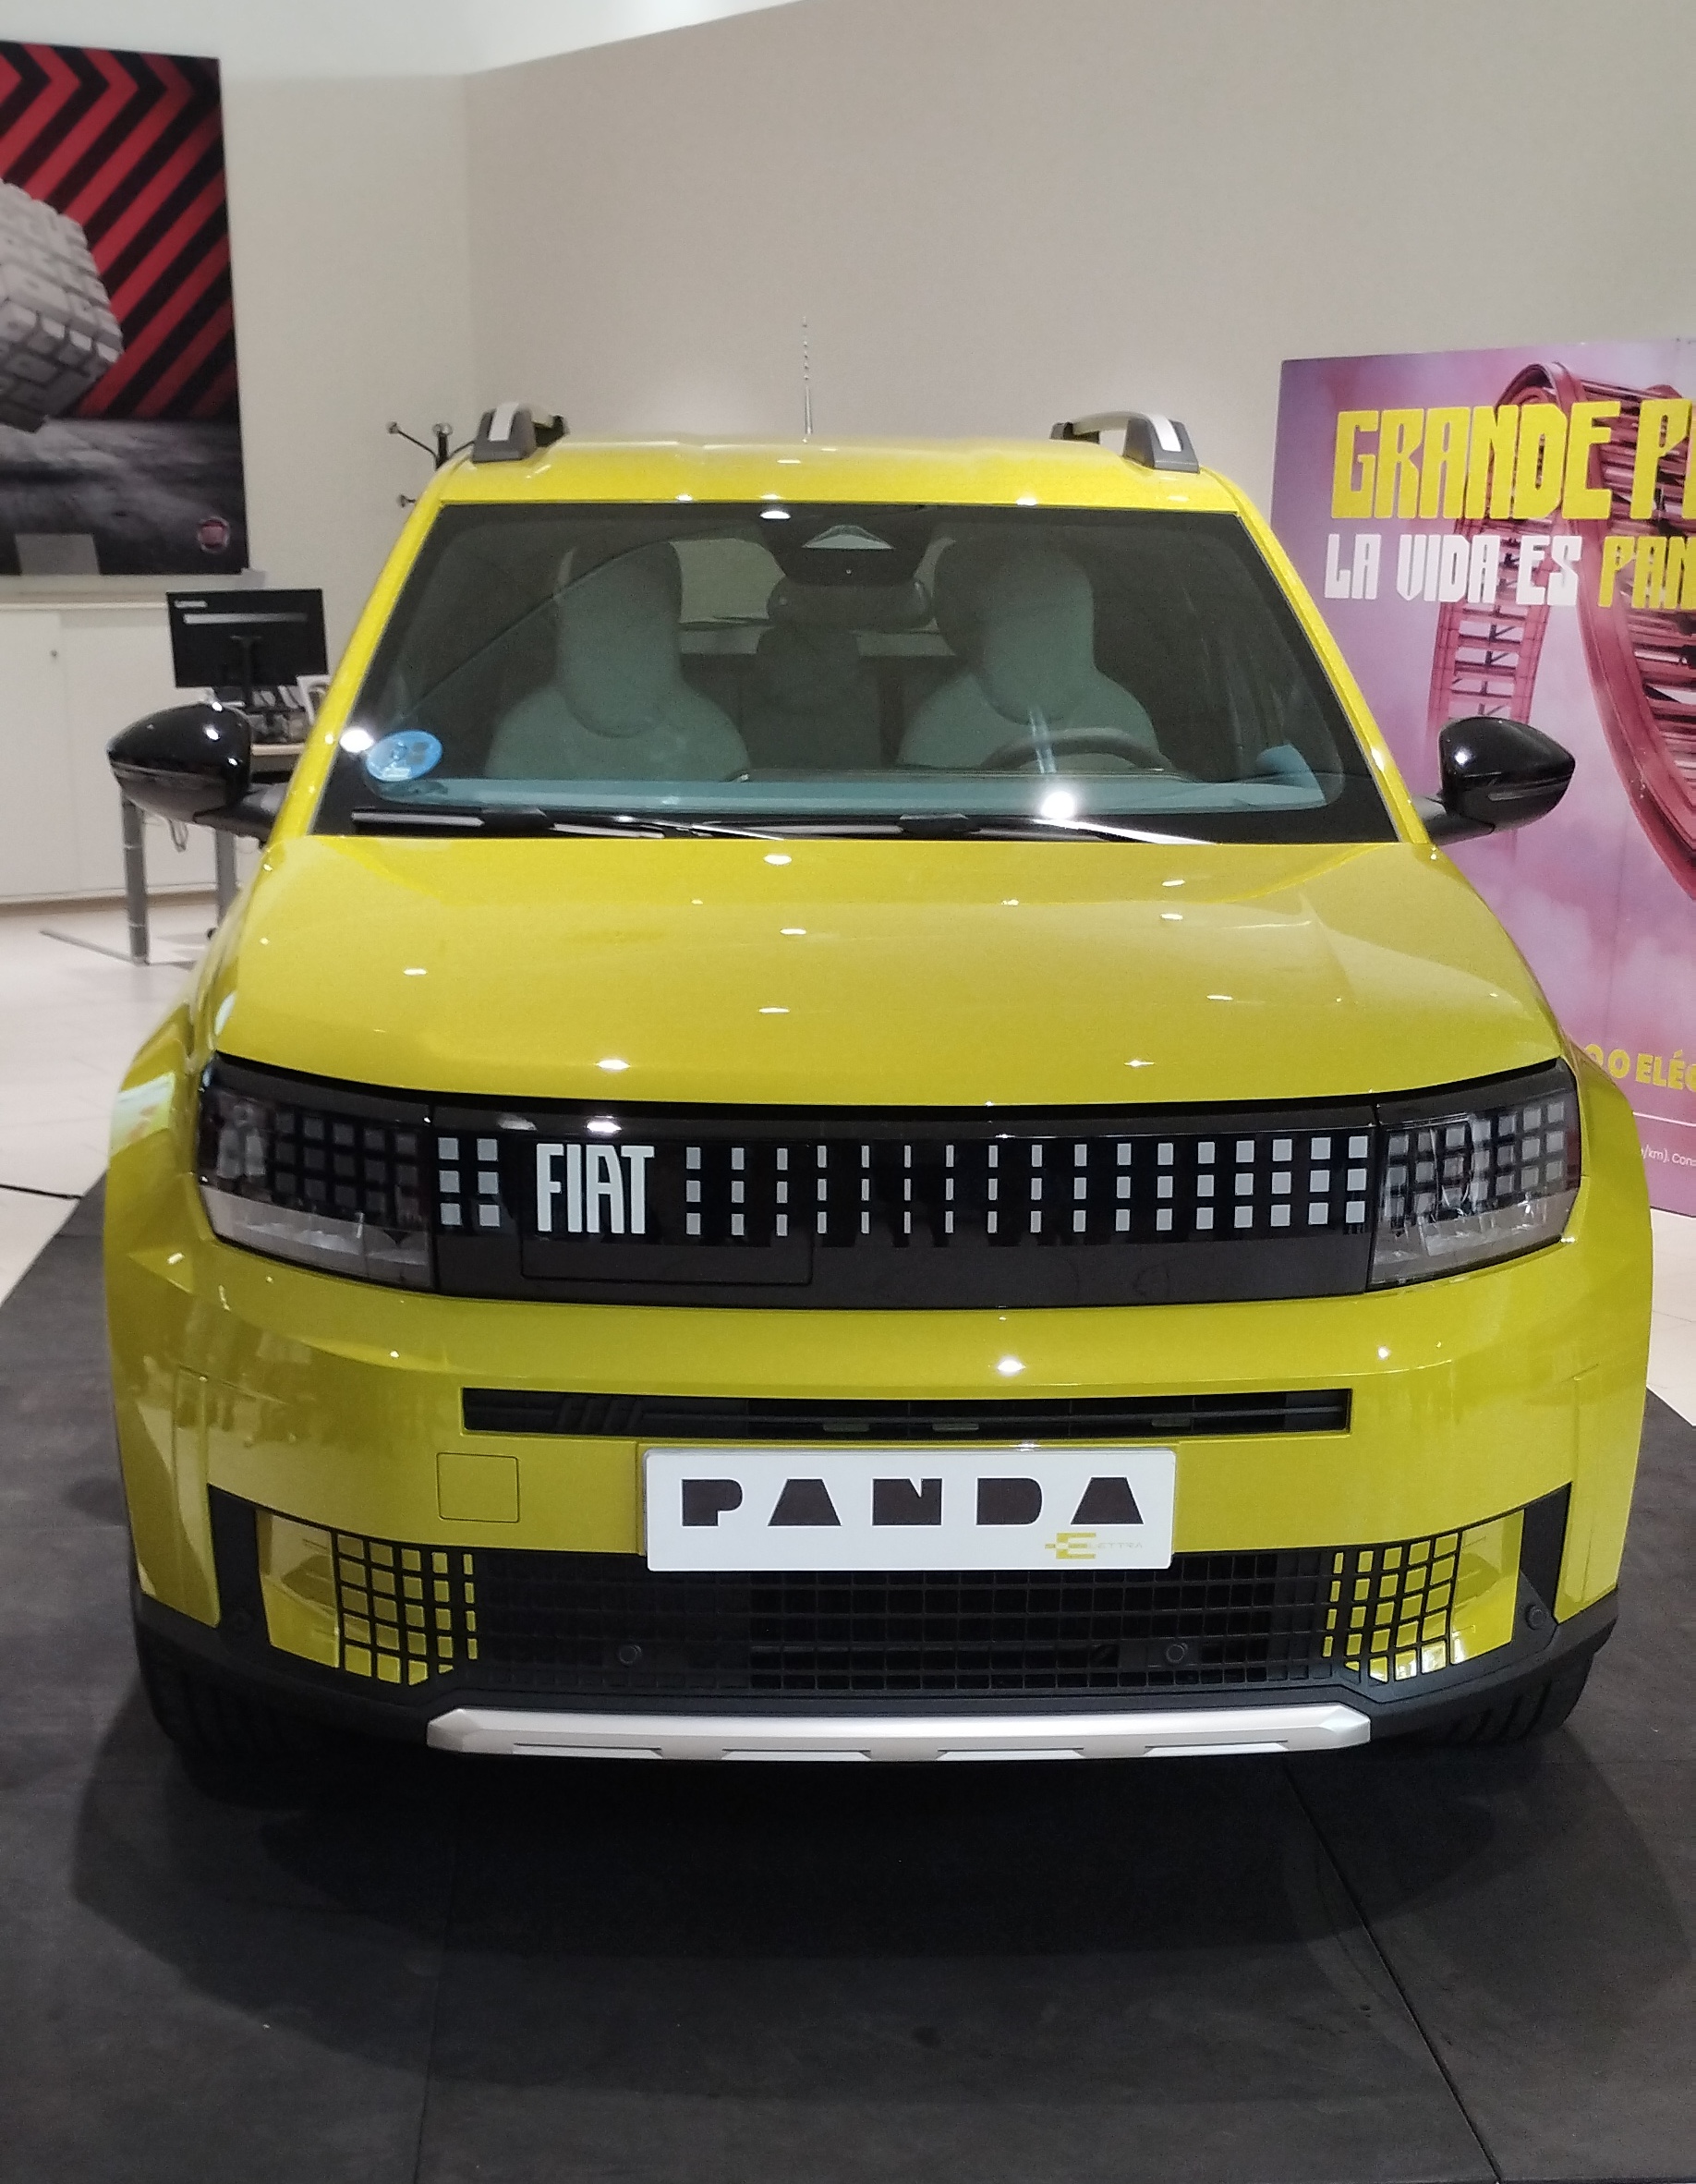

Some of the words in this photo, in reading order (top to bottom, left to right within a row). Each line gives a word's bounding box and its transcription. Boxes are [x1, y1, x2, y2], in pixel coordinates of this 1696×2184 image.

[1331, 401, 1621, 520] GRANDE
[1629, 398, 1696, 520] P
[1324, 533, 1382, 601] LA
[1396, 534, 1501, 604] VIDA
[1516, 535, 1583, 606] ES
[536, 1143, 655, 1234] FIAT
[681, 1476, 1145, 1527] PANDA
